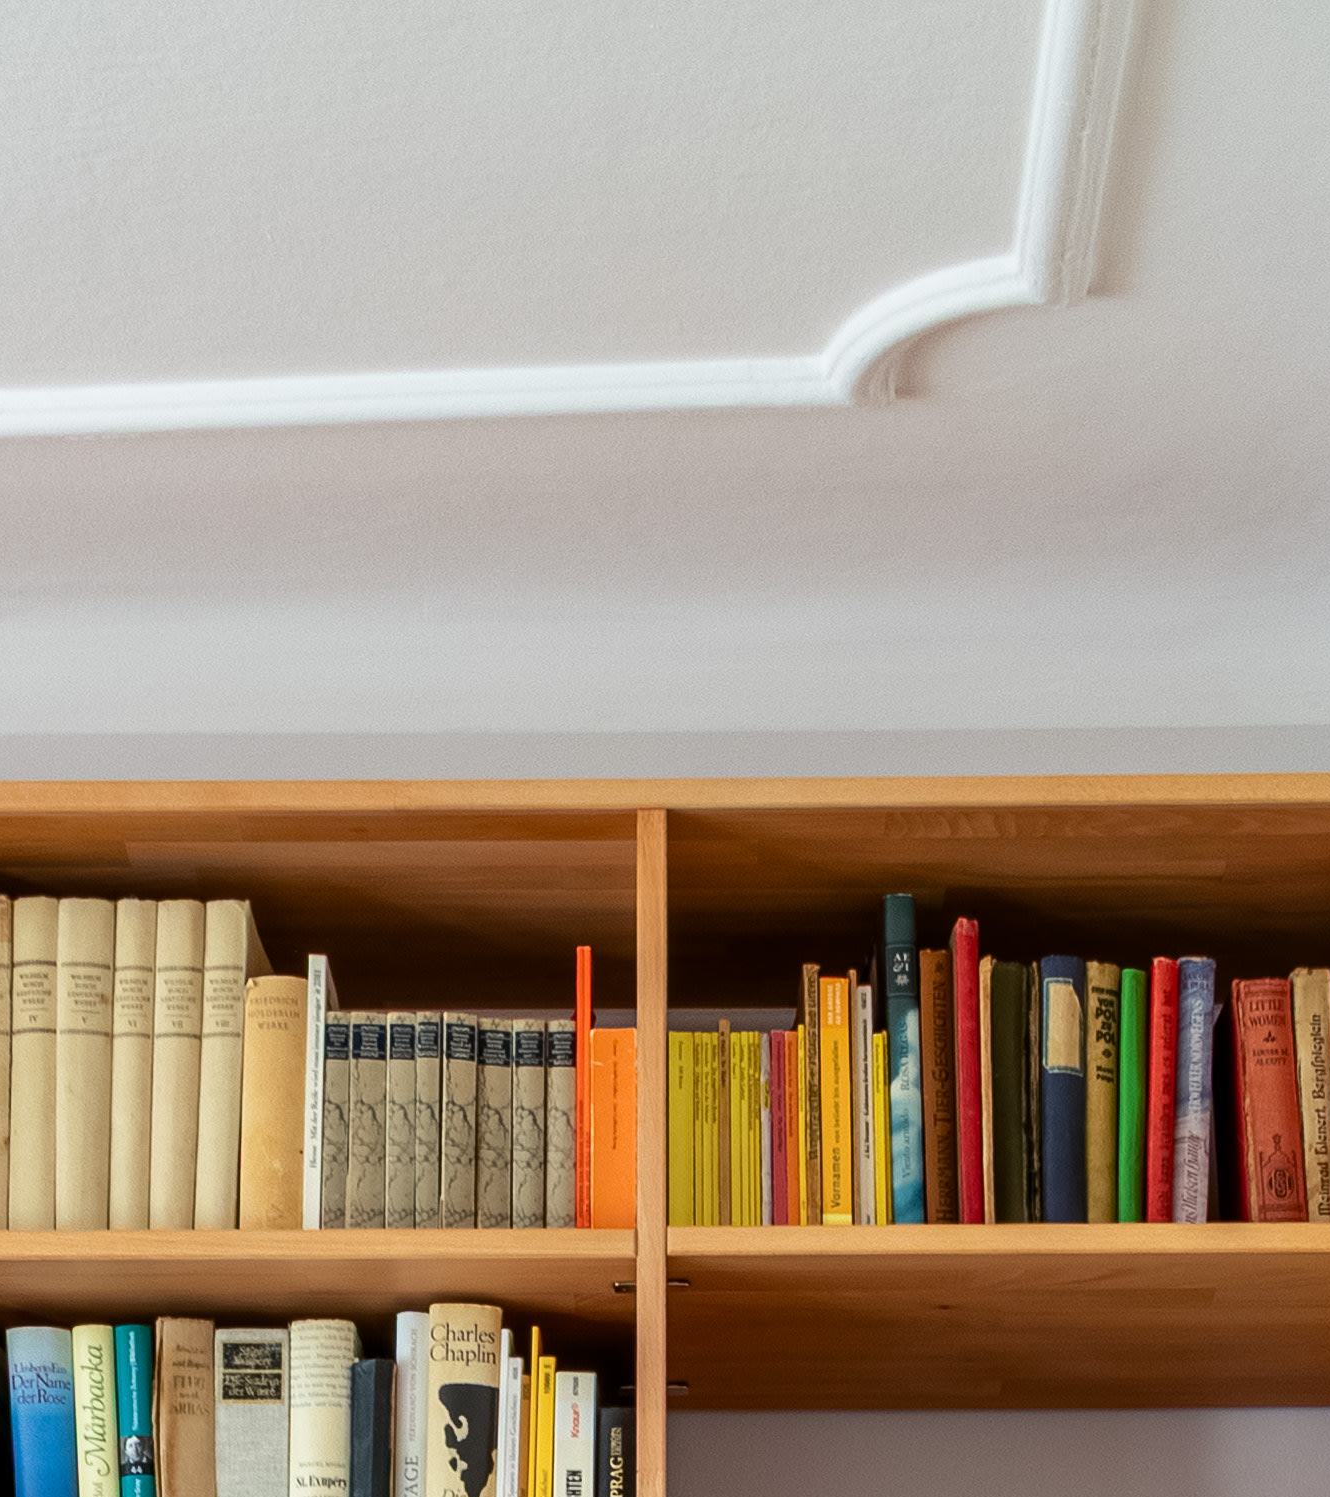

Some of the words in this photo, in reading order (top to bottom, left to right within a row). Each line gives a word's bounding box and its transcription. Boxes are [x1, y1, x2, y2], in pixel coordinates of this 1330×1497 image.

[831, 1148, 840, 1208] Vornamen
[430, 1324, 496, 1343] Charles
[430, 1343, 496, 1366] Chaplin
[12, 1375, 39, 1390] Der
[40, 1376, 72, 1390] Name
[18, 1391, 39, 1404] der
[38, 1391, 67, 1404] Rose
